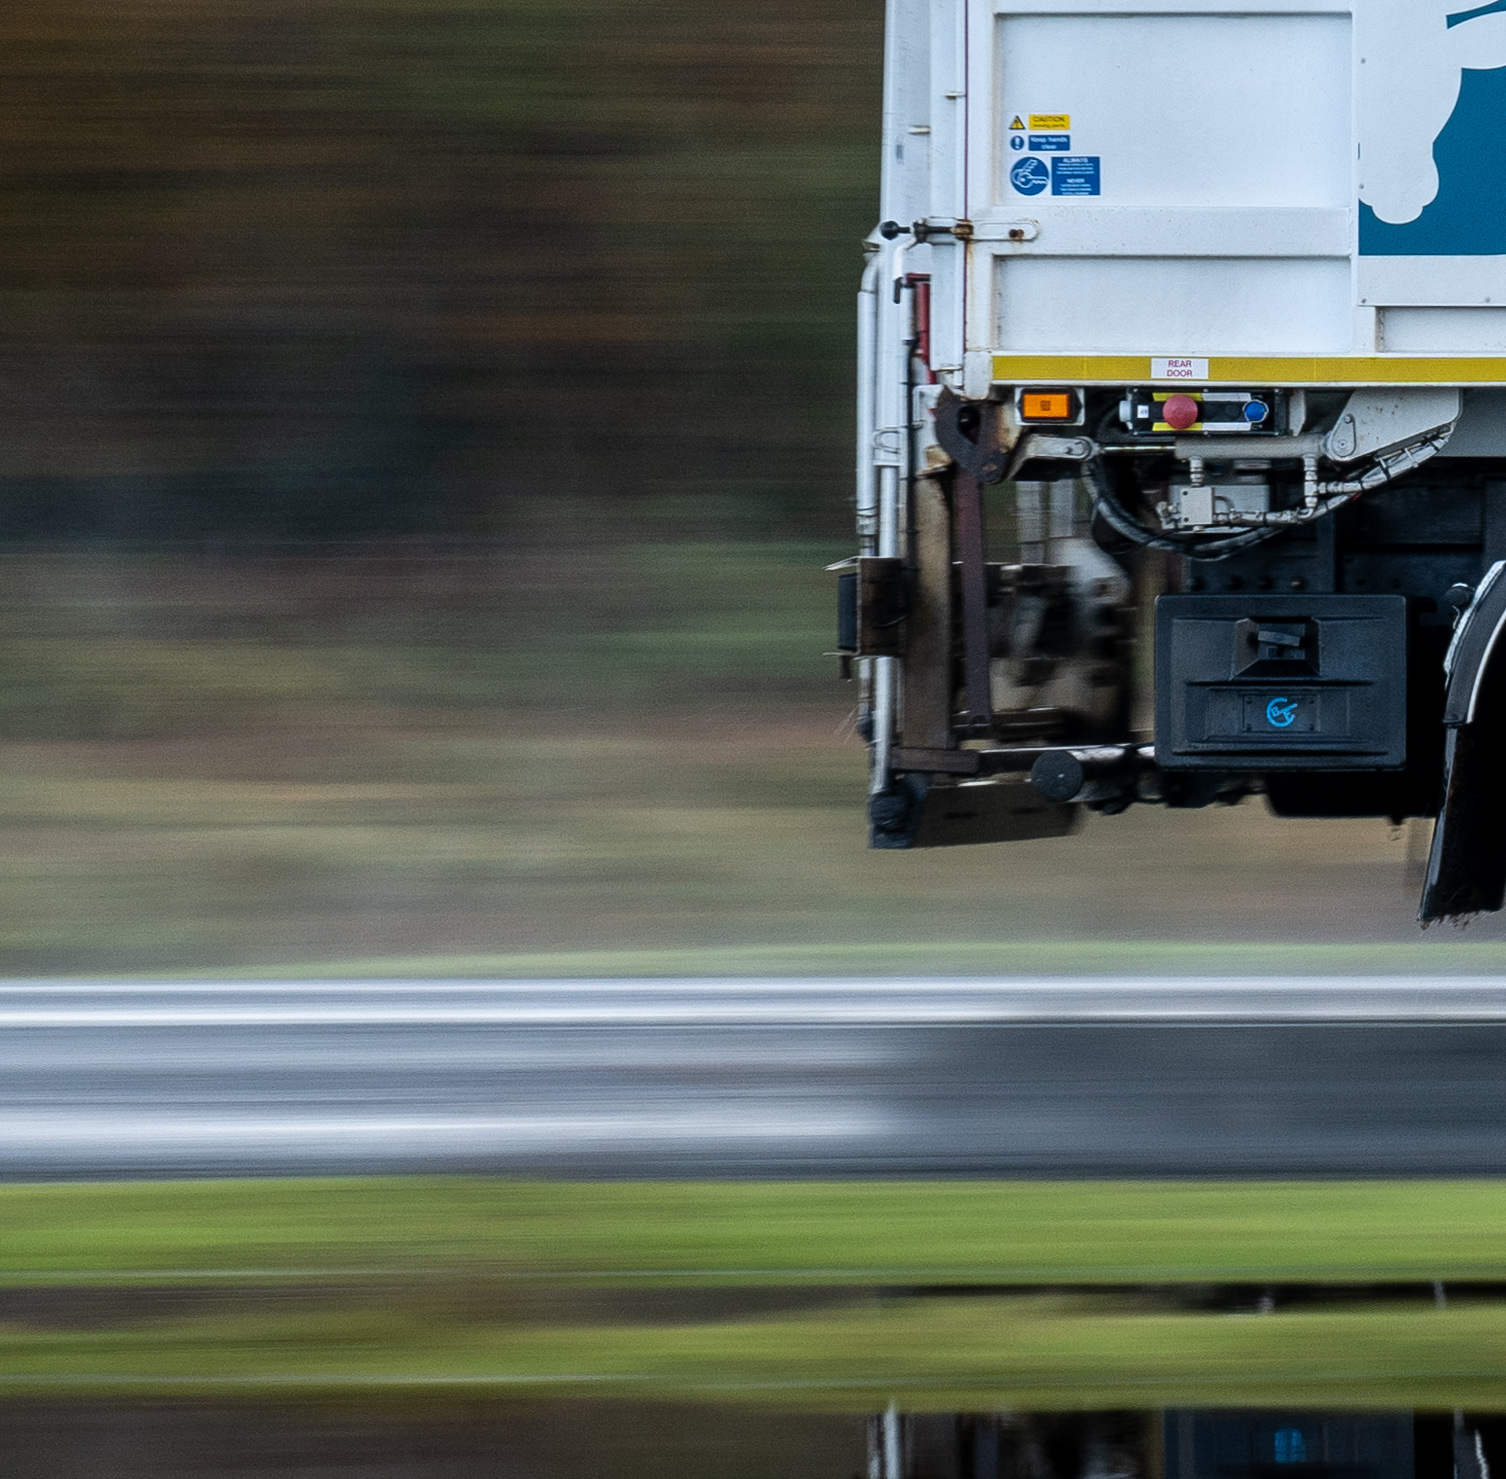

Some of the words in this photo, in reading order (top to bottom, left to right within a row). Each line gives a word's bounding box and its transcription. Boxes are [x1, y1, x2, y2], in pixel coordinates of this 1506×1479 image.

[1033, 115, 1066, 123] CAUTION
[1168, 359, 1192, 368] REAR
[1166, 369, 1193, 377] DOOR
